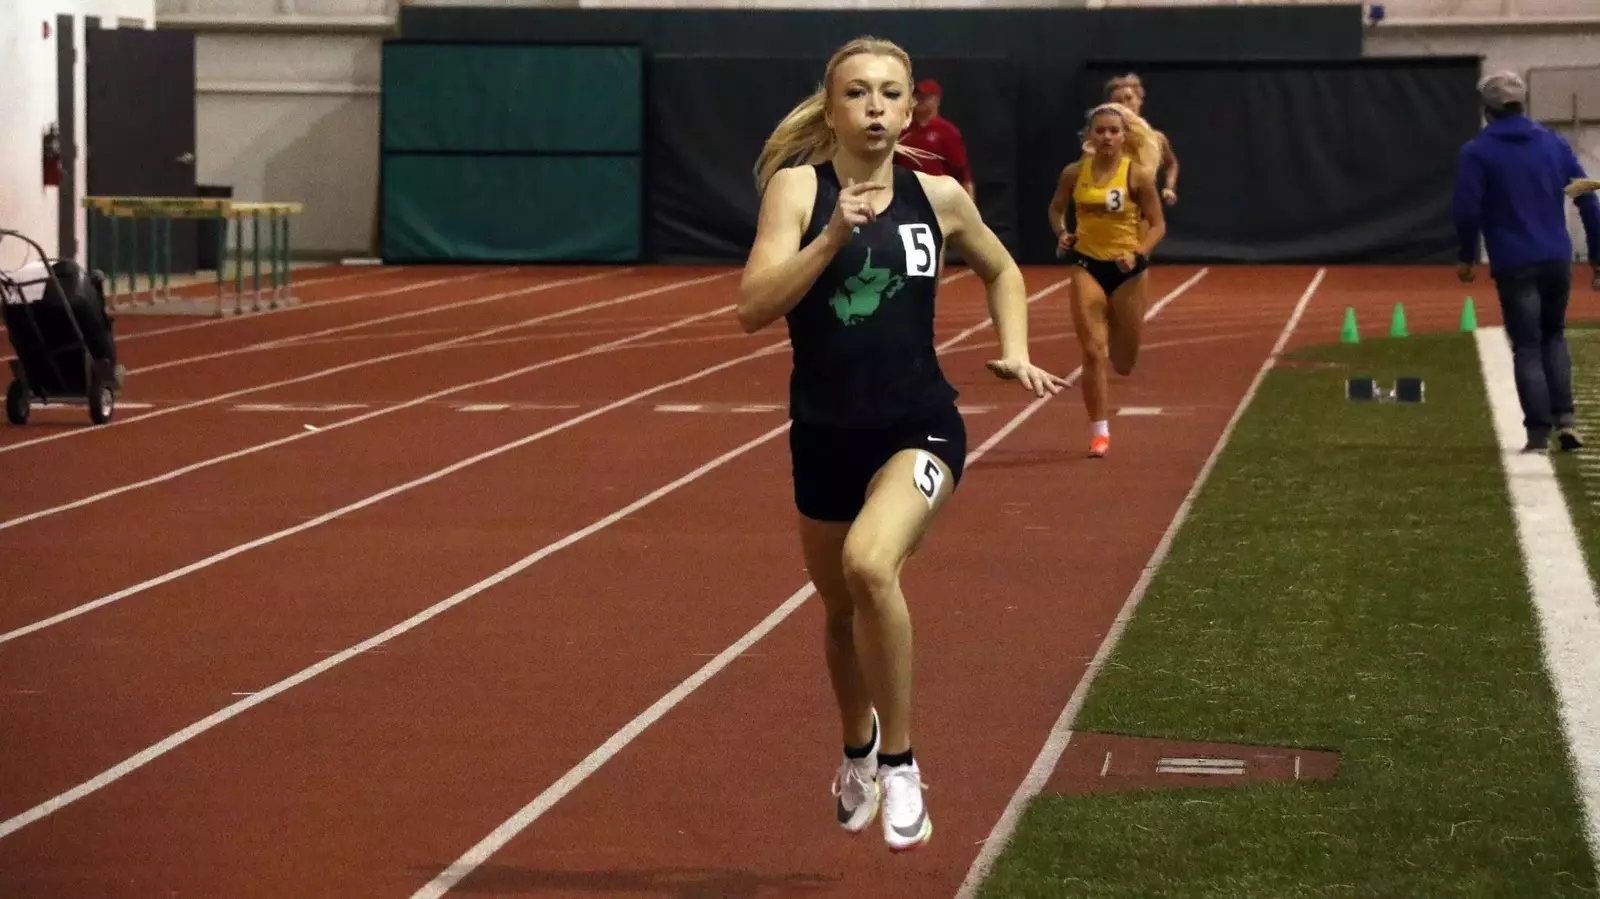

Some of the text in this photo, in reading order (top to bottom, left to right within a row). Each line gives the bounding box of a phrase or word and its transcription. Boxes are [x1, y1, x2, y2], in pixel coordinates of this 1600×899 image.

[1110, 189, 1121, 211] 3
[911, 227, 931, 273] 5
[920, 459, 939, 498] 5
